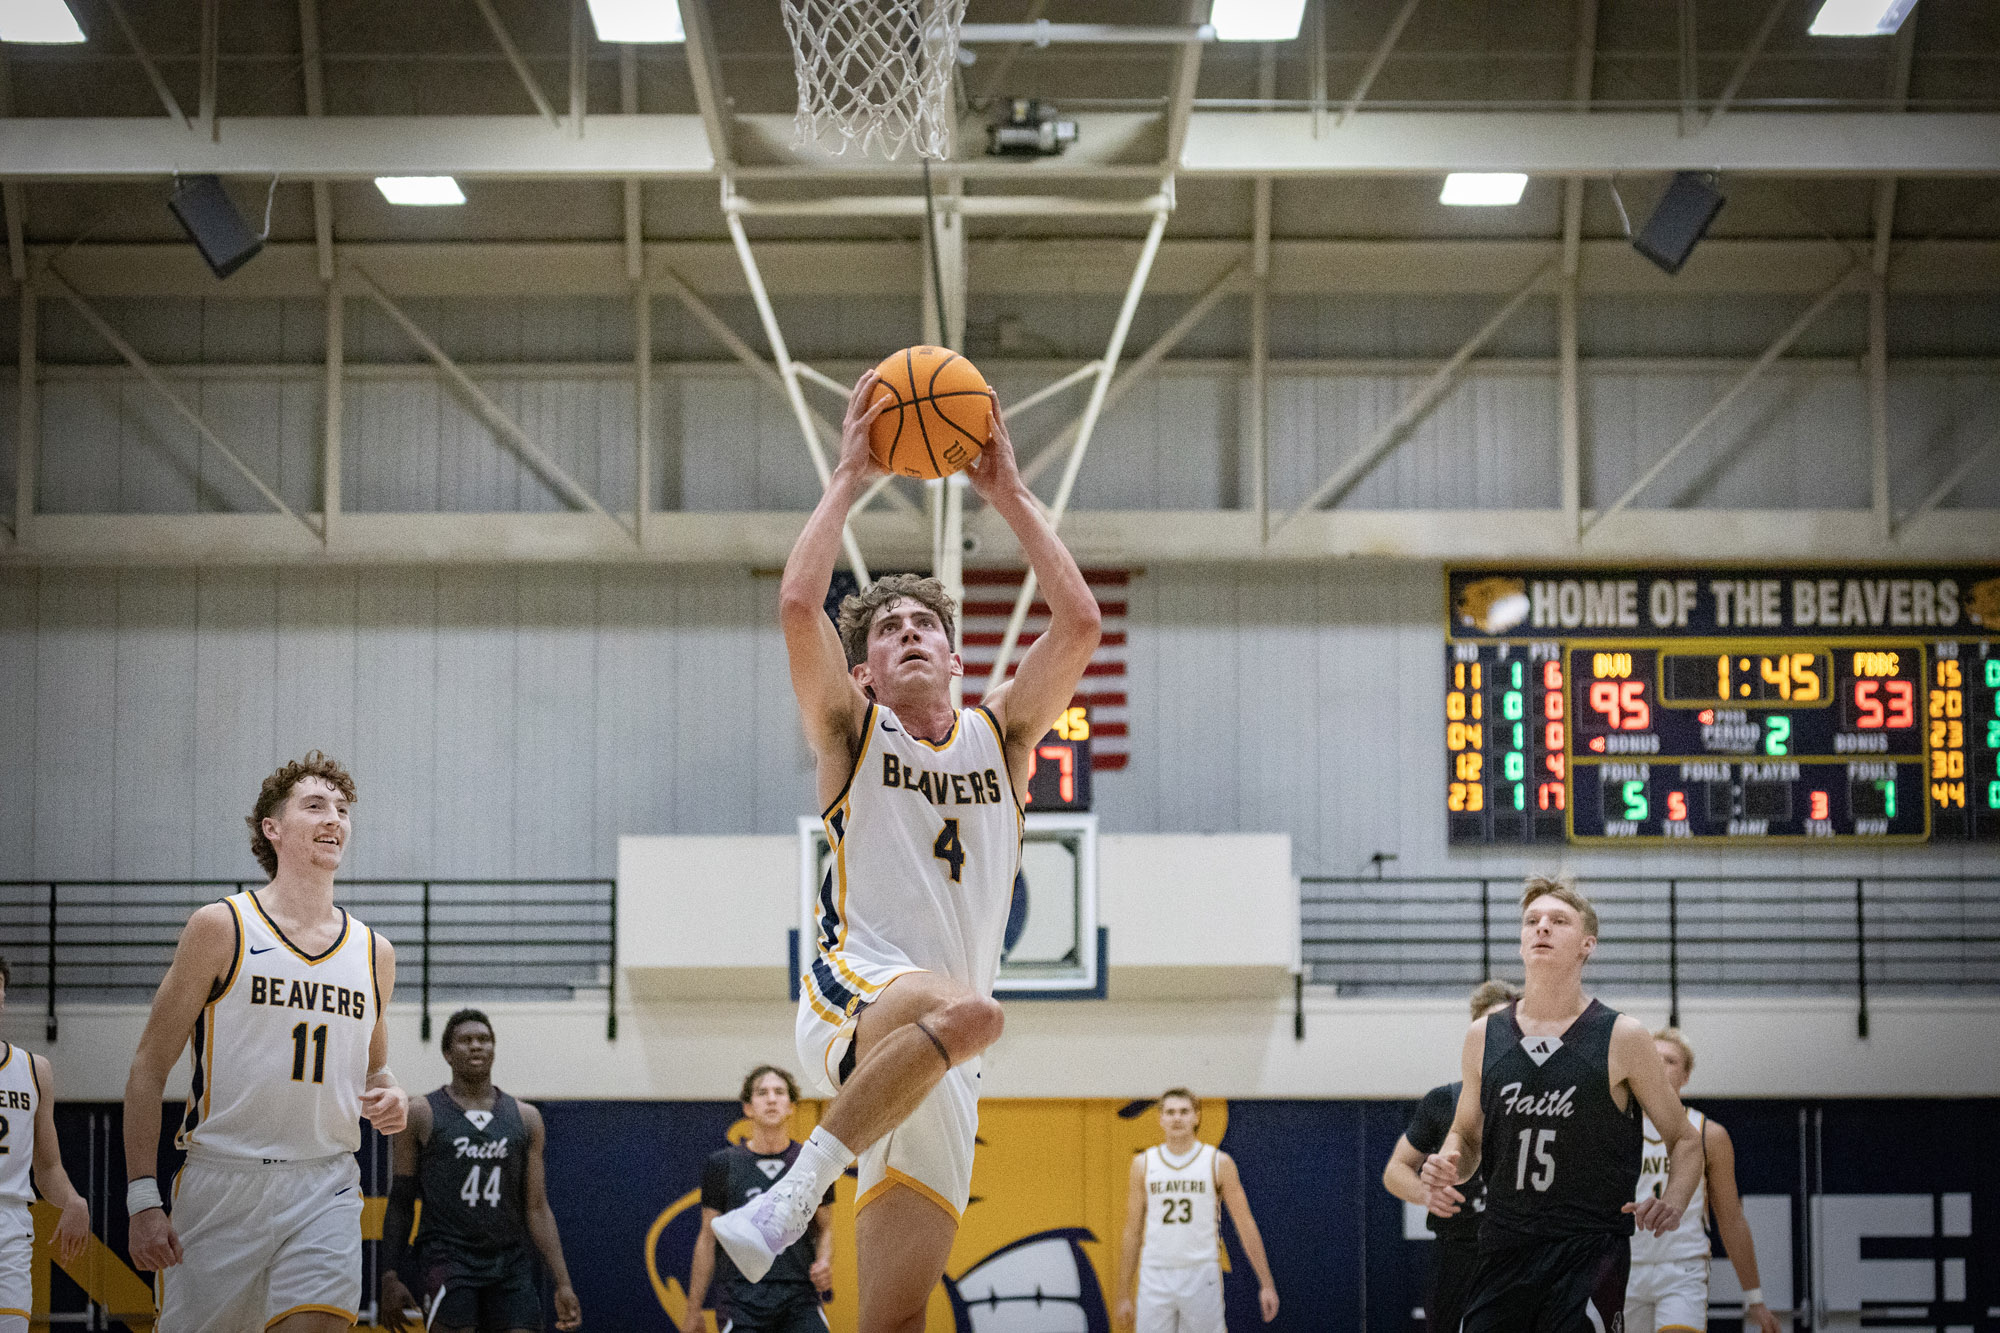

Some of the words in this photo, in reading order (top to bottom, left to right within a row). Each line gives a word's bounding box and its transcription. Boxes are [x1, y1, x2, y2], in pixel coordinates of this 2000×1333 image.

[1530, 579, 1639, 628] HOME
[1650, 579, 1698, 628] OF
[1711, 579, 1782, 627] THE
[1793, 579, 1961, 627] BEAVERS
[1455, 662, 1481, 689] 11
[1512, 661, 1522, 689] 1
[1544, 661, 1563, 689] 6
[1718, 653, 1820, 701] 1:45
[1937, 660, 1962, 687] 15
[1447, 691, 1482, 720] 01
[1503, 691, 1522, 720] 0
[1544, 691, 1563, 720] 0
[1590, 681, 1649, 730] 95
[1855, 680, 1913, 728] 53
[1929, 690, 1962, 718] 20
[1447, 721, 1483, 750] 04
[1513, 721, 1523, 750] 1
[1545, 721, 1564, 750] 0
[1605, 734, 1660, 753] BONUS
[1765, 716, 1790, 756] 2
[1834, 733, 1888, 753] BONUS
[1930, 720, 1963, 748] 23
[882, 752, 1002, 805] BEAVERS
[1024, 746, 1074, 803] 7
[1504, 751, 1524, 781] 0
[1546, 752, 1565, 780] 4
[1601, 764, 1649, 781] FOULS
[1680, 763, 1731, 781] FOULS
[1741, 763, 1800, 781] PLAYER
[1847, 762, 1897, 781] FOULS
[1931, 750, 1964, 778] 30
[1448, 782, 1483, 811] 23
[1513, 782, 1524, 811] 1
[1539, 782, 1565, 811] 17
[1623, 781, 1648, 820] 5
[1667, 791, 1687, 820] 5
[1810, 791, 1828, 820] 3
[1931, 781, 1965, 809] 44
[1727, 819, 1769, 836] GAME
[932, 818, 966, 885] 4
[250, 975, 367, 1020] BEAVERS
[291, 1021, 329, 1085] 11
[1500, 1081, 1577, 1118] Faith
[453, 1136, 509, 1159] Faith
[1516, 1127, 1557, 1192] 15
[460, 1164, 502, 1208] 44
[1150, 1181, 1206, 1194] BEAVERS
[1162, 1197, 1193, 1225] 23
